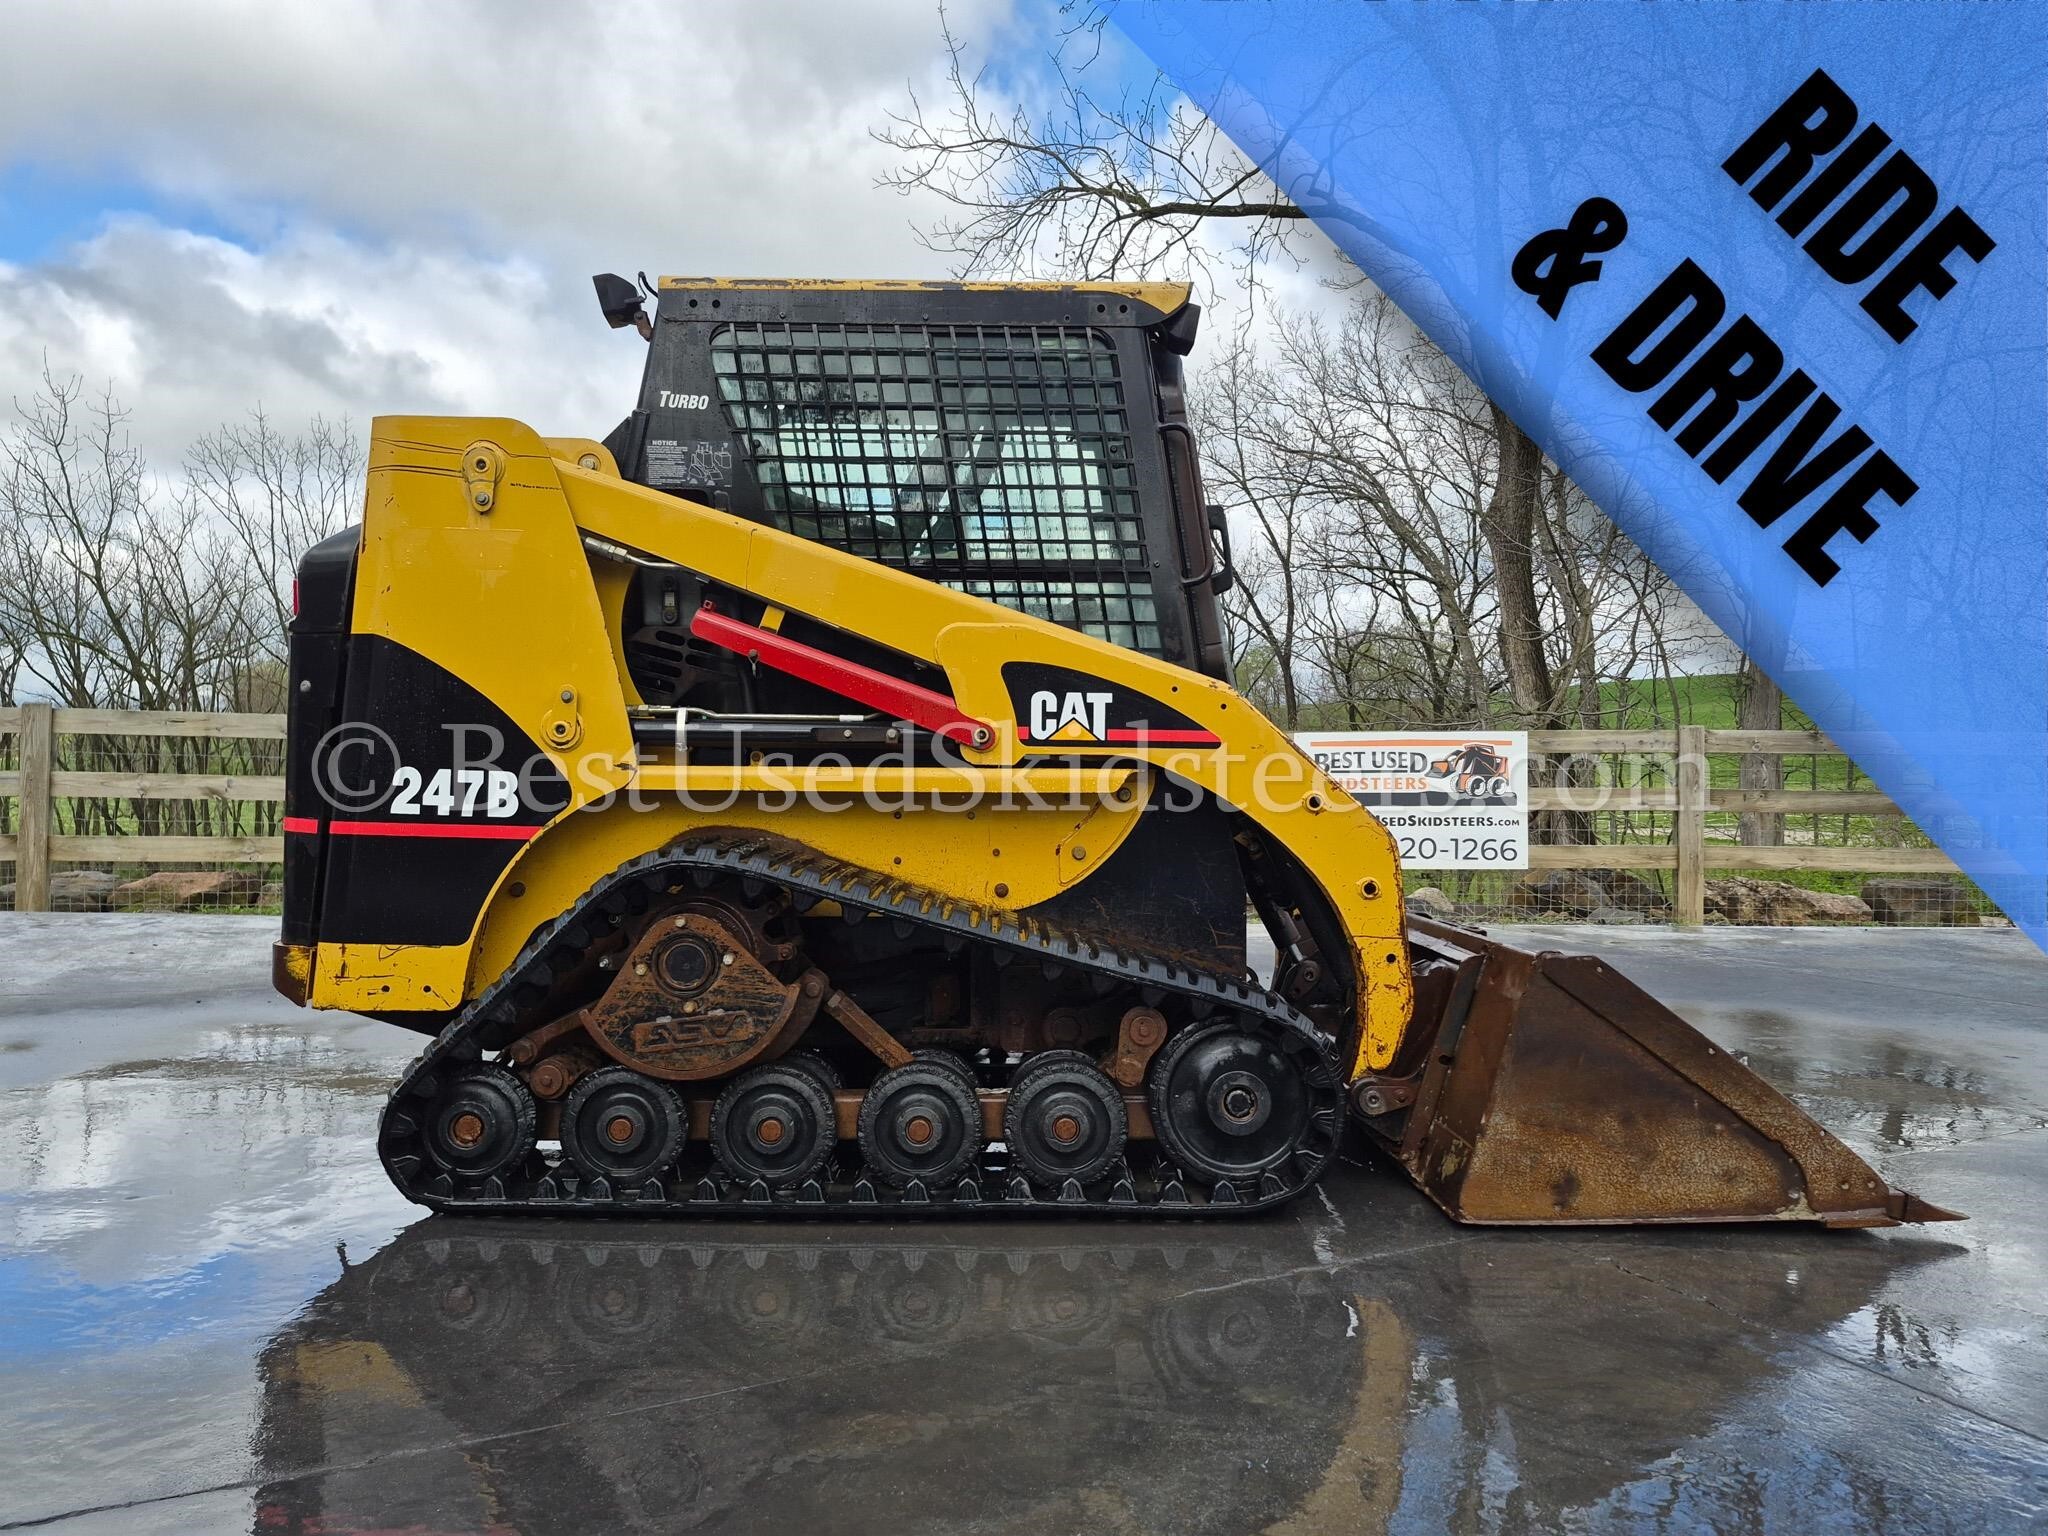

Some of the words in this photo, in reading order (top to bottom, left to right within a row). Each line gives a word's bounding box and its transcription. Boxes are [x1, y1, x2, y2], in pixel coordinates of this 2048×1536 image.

[1030, 690, 1113, 741] CAT
[1314, 752, 1366, 773] BEST
[1371, 751, 1428, 773] USED
[390, 766, 519, 818] 247B
[1400, 837, 1518, 861] 20-1266
